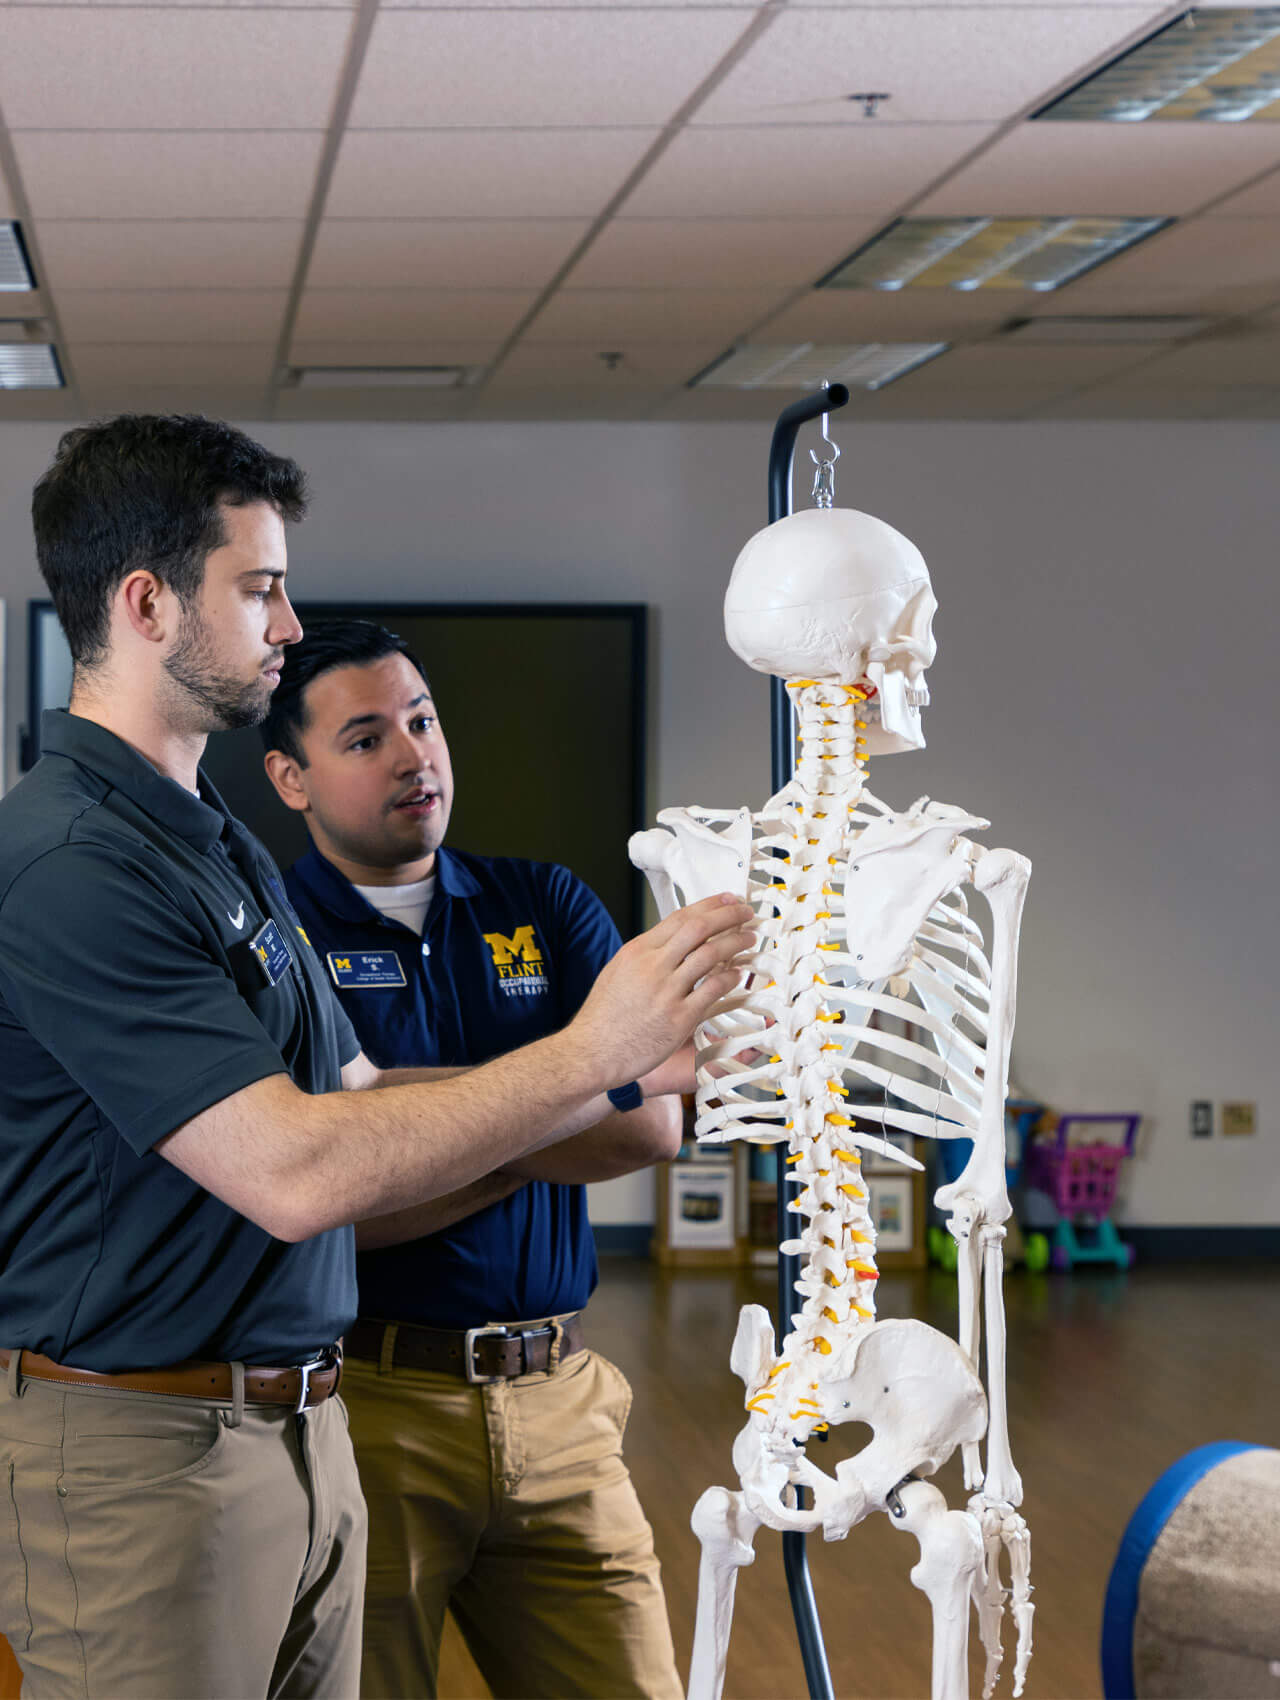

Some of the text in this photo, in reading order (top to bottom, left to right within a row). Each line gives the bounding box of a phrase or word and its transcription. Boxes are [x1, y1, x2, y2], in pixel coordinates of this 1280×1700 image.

[482, 924, 543, 964] M
[334, 958, 352, 969] M
[361, 956, 384, 964] Erick
[496, 962, 544, 978] FLINT
[504, 985, 548, 997] THERAPY
